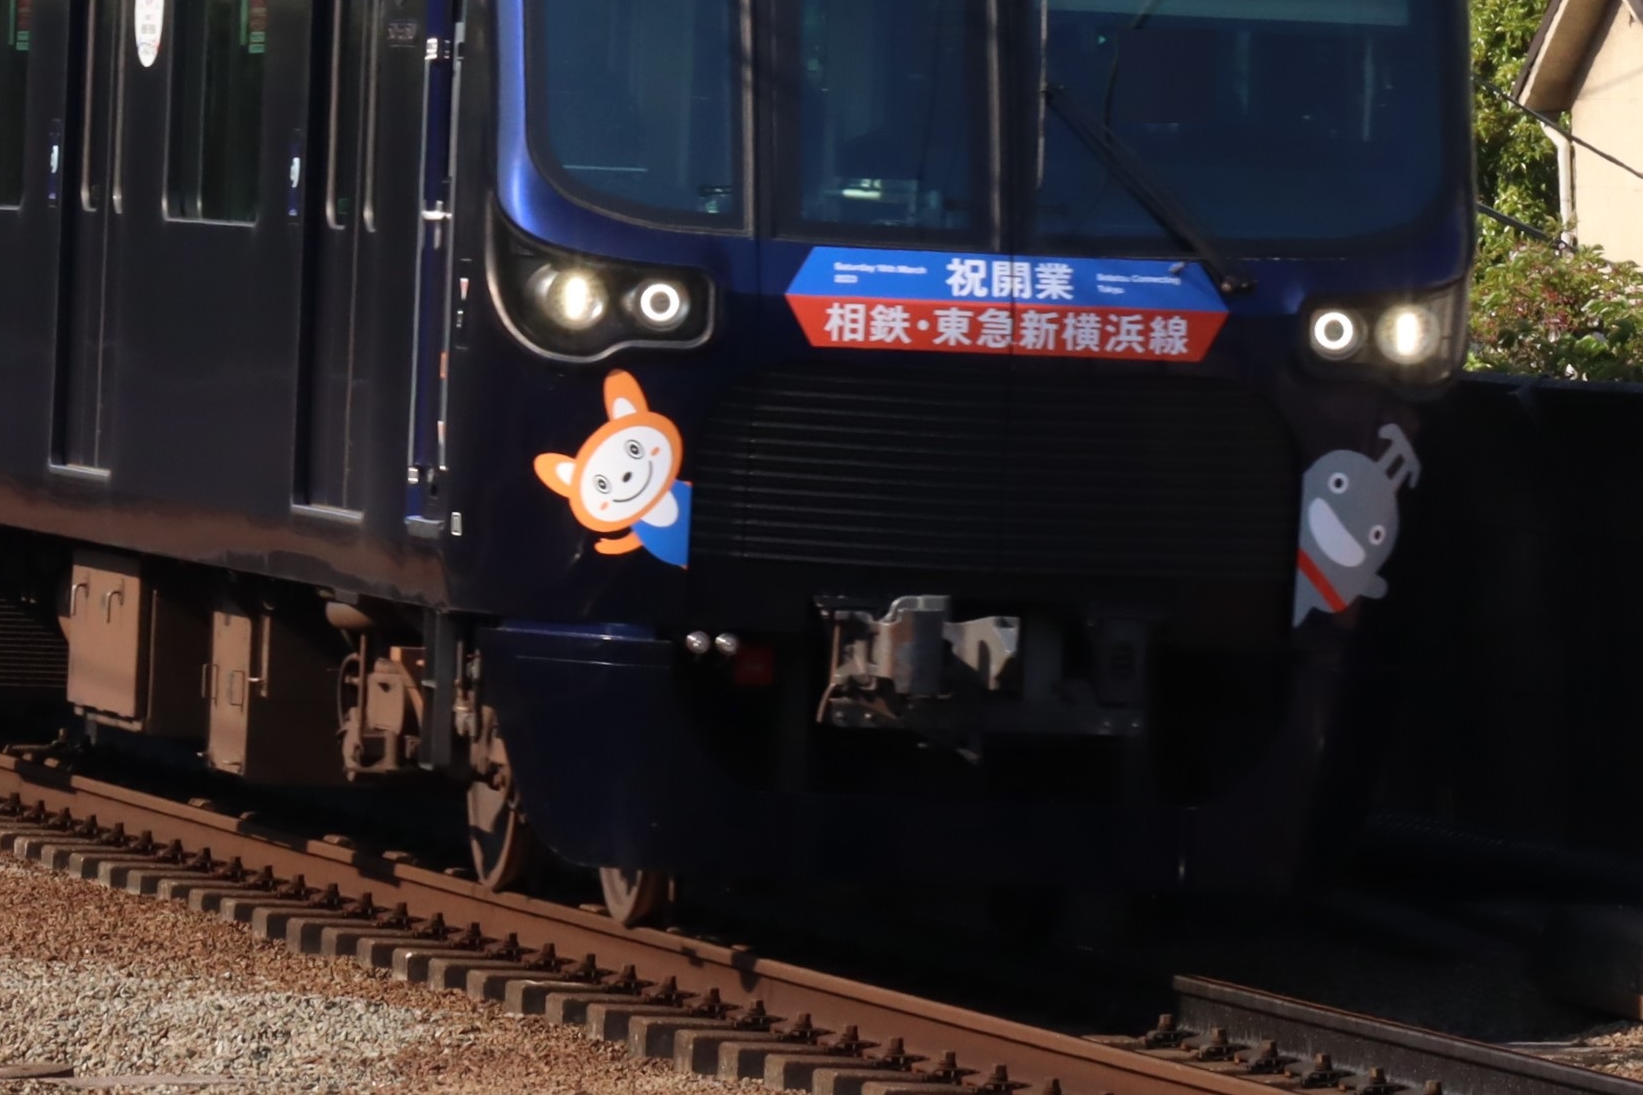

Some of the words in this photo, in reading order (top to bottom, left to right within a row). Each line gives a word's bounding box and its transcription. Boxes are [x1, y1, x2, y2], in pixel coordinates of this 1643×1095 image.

[945, 256, 1075, 301] 祝開業
[823, 300, 1189, 356] 相鉄・東急新横浜線
